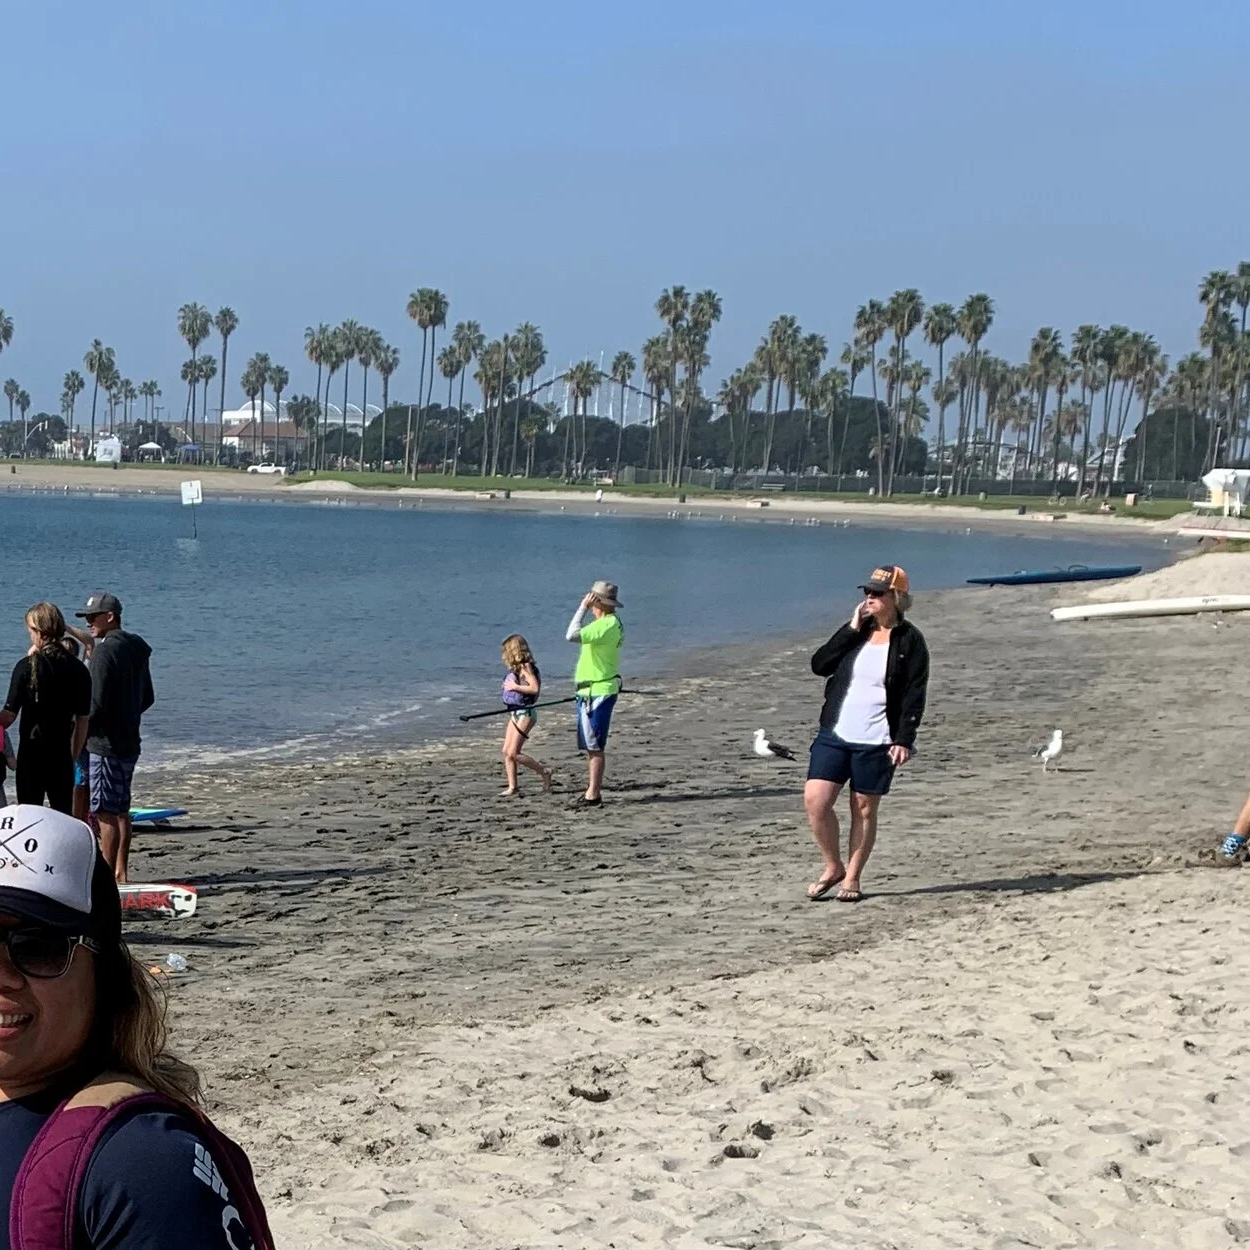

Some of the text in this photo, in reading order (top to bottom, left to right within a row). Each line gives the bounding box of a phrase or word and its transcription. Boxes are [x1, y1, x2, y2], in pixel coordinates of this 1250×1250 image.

[0, 816, 15, 830] R
[24, 838, 38, 853] O
[121, 892, 173, 911] ARK
